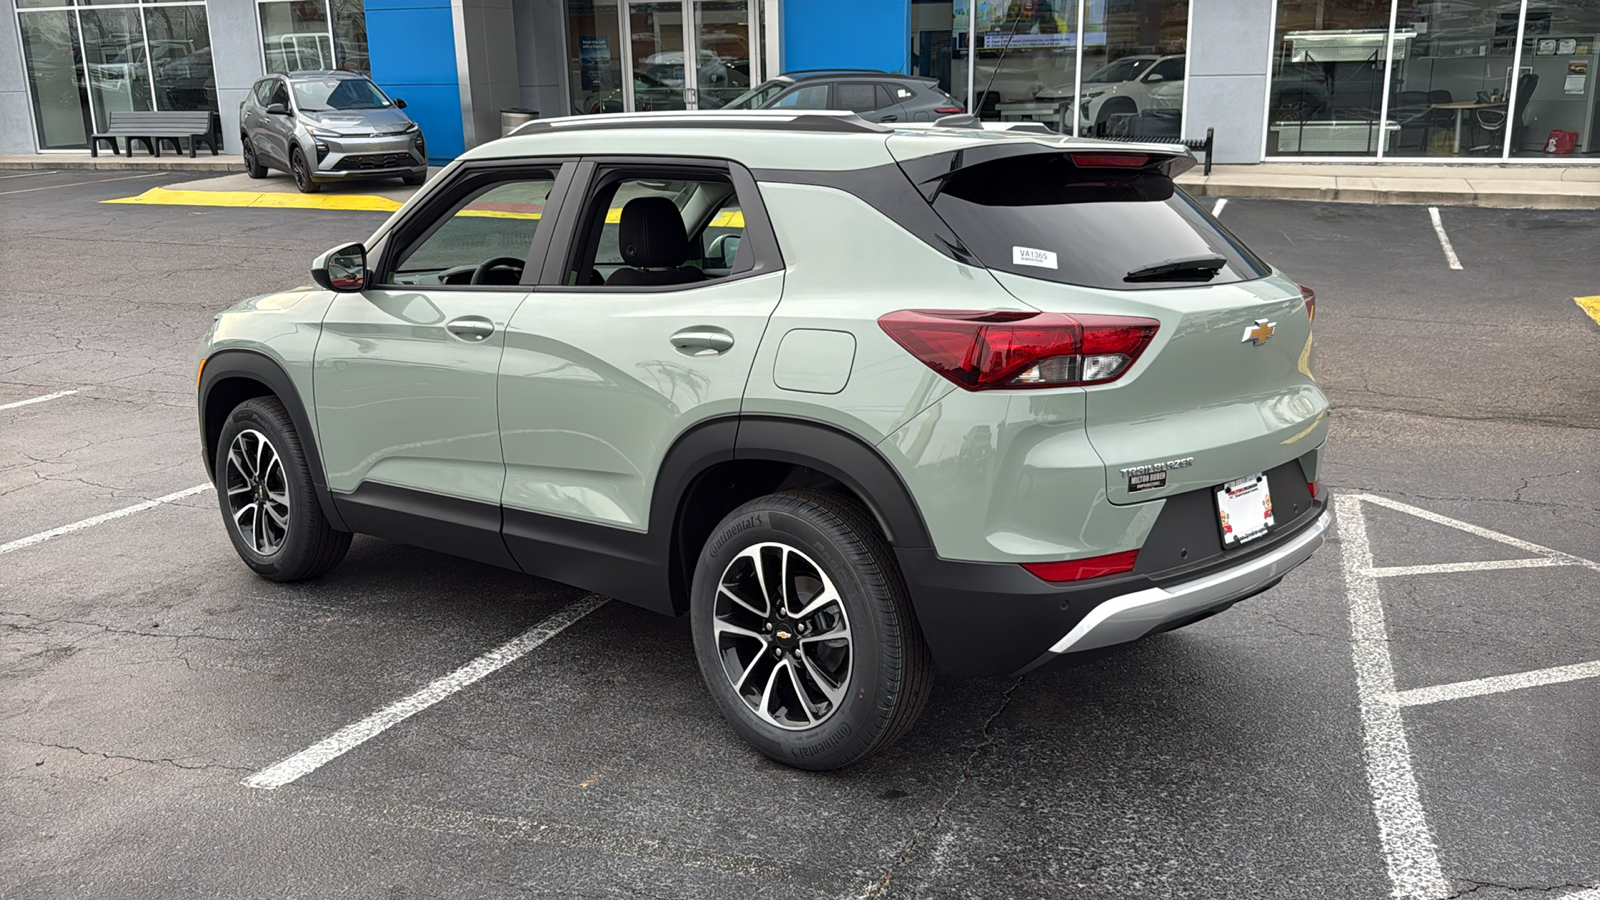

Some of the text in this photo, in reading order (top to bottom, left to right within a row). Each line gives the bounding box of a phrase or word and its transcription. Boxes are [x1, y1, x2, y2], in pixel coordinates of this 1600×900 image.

[1019, 249, 1048, 260] VA1365
[1119, 457, 1194, 478] TRAILBLAZER
[710, 515, 755, 558] Continental
